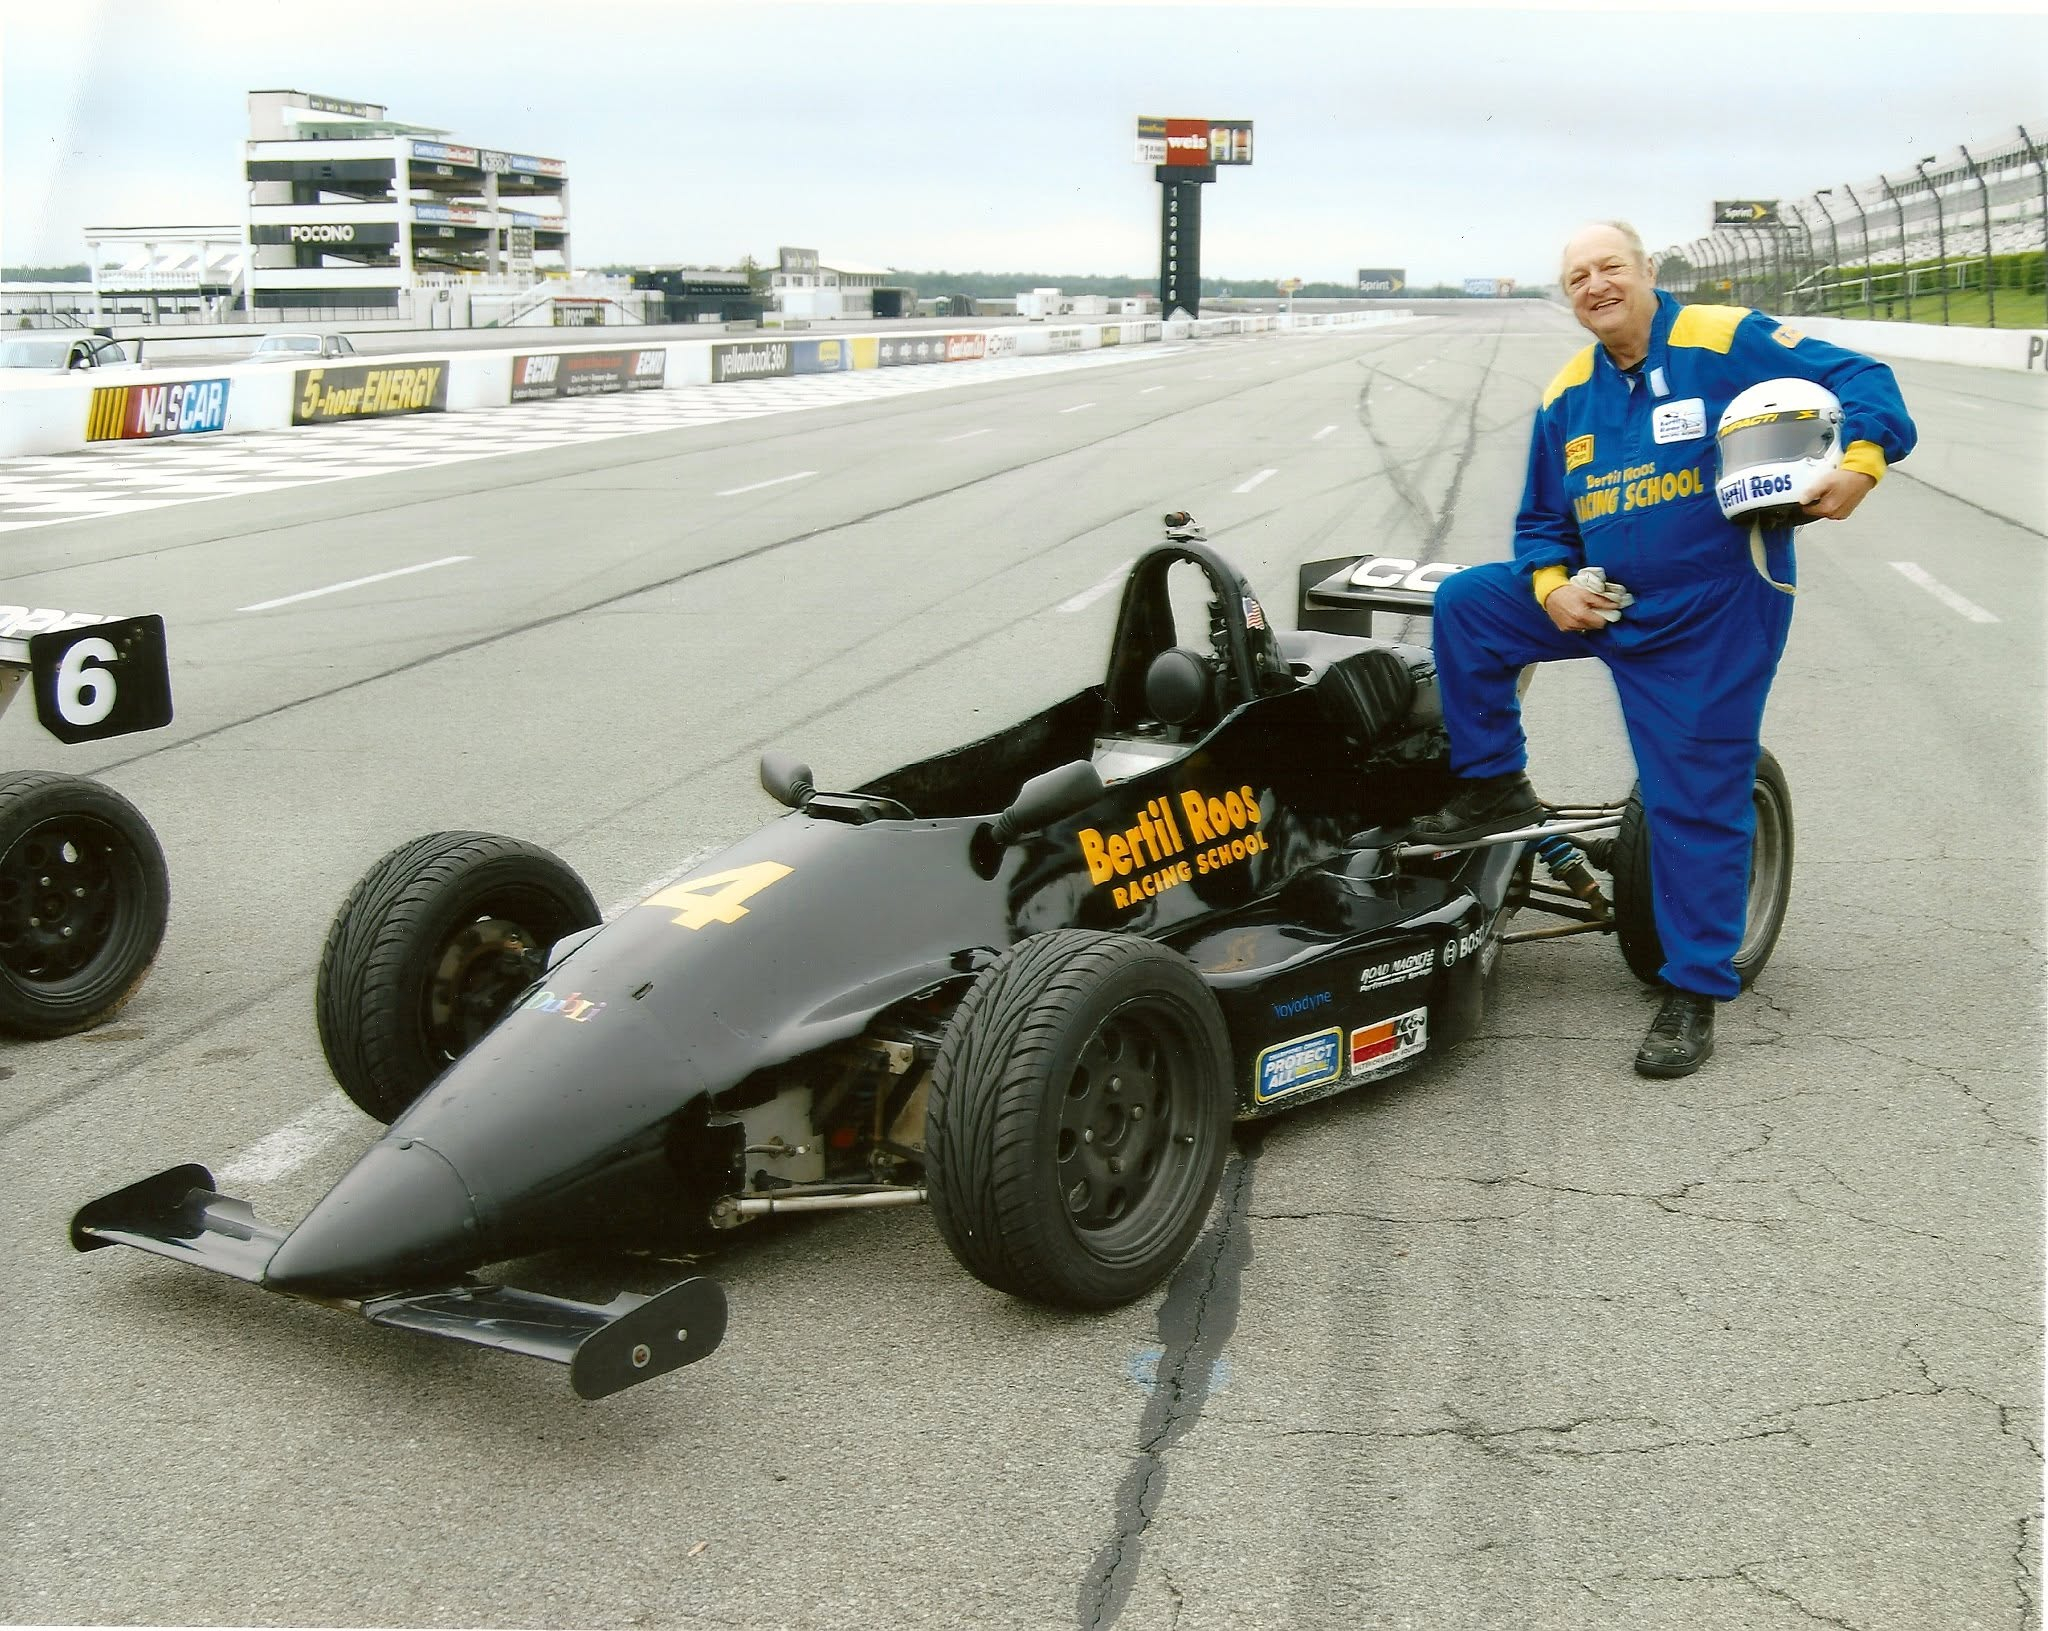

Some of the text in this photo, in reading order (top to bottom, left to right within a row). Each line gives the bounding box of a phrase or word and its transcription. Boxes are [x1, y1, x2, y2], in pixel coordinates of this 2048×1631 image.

[1171, 185, 1178, 198] 1
[1170, 200, 1178, 213] 2
[290, 224, 355, 243] POCONO
[1169, 215, 1178, 228] 3
[1169, 230, 1178, 242] 4
[1169, 245, 1177, 258] 5
[1169, 260, 1177, 272] 6
[1169, 274, 1177, 286] 7
[1360, 279, 1391, 293] Sprint
[1169, 289, 1177, 302] 8
[524, 354, 560, 385] ECHO
[635, 350, 666, 376] ECHO
[721, 343, 788, 382] yellowbook360
[301, 366, 441, 419] 5-hour ENERGY
[137, 382, 223, 433] NASCAR
[1586, 461, 1656, 490] Bertil Roos
[1750, 473, 1793, 499] Roos
[1623, 466, 1705, 512] SCHOOL
[57, 637, 119, 726] 6
[1078, 785, 1262, 886] Bertil Roos
[1112, 830, 1269, 910] RACING SCHOOL
[639, 860, 796, 931] 4
[1360, 963, 1390, 984] ROAD
[1264, 1042, 1337, 1078] PROTECT
[1267, 1069, 1296, 1091] ALL
